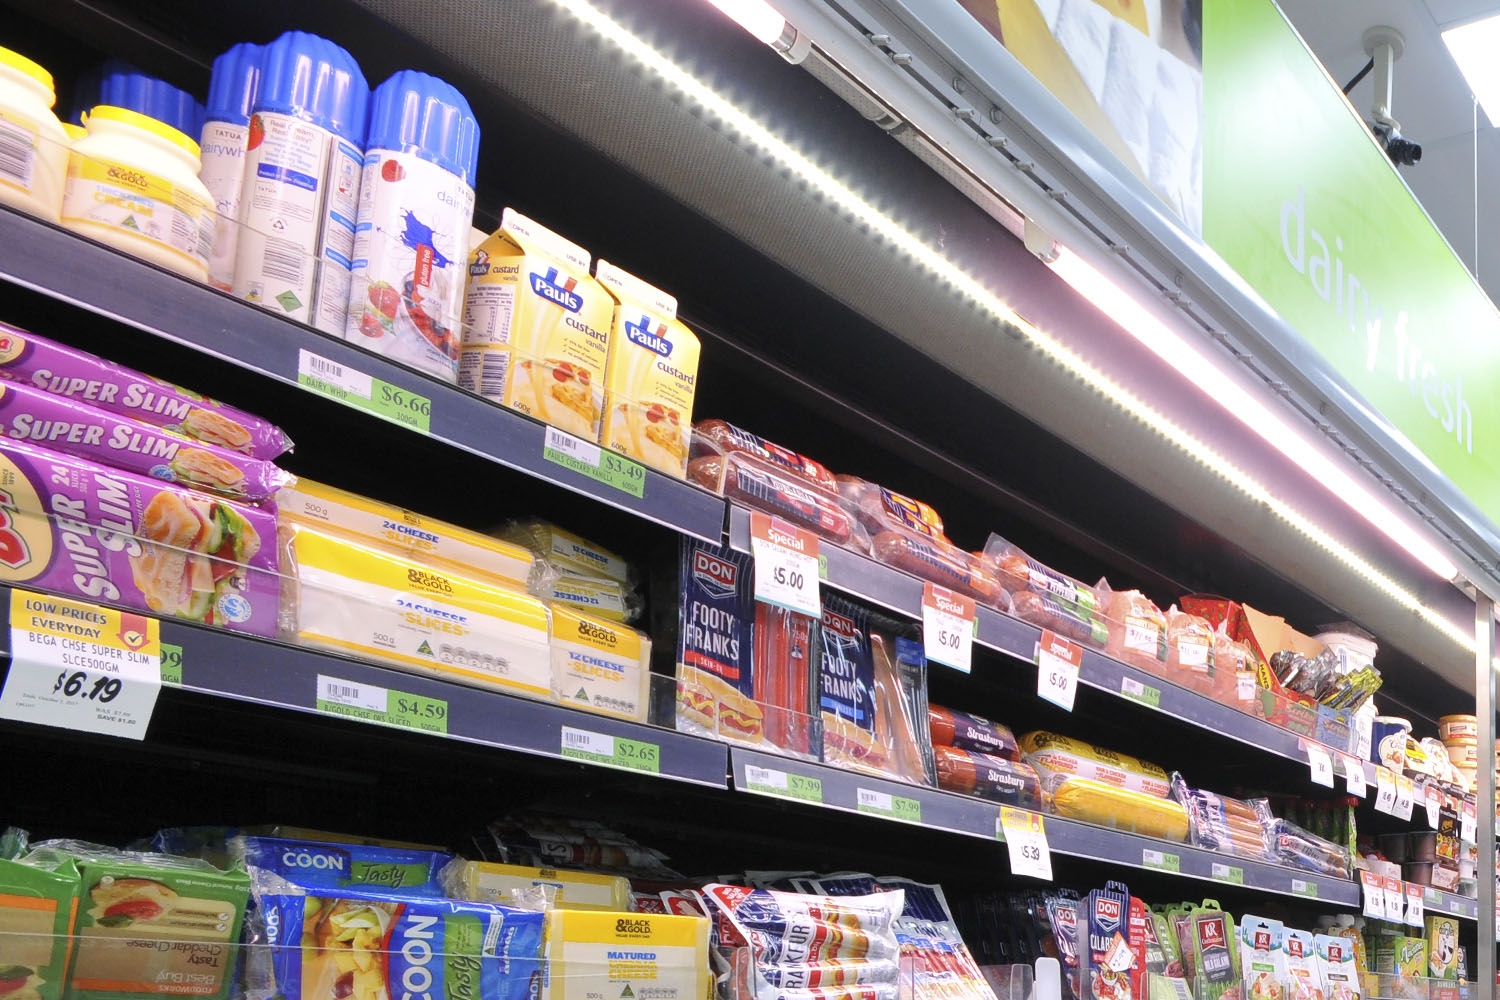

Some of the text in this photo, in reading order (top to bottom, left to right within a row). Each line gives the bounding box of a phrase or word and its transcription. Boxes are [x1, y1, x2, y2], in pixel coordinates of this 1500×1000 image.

[534, 277, 579, 311] Pauls
[565, 316, 608, 344] custard
[1280, 186, 1473, 455] dairy fresh
[585, 338, 607, 354] vanilla
[628, 329, 671, 357] Pauls
[656, 360, 696, 386] custard
[30, 369, 191, 420] SUPER SLIM
[306, 376, 349, 400] DAIRY WHIP
[381, 385, 431, 417] $6.66
[512, 400, 532, 415] 600g
[9, 412, 181, 460] SUPER SLIM
[604, 455, 644, 481] $3.49
[51, 473, 145, 601] SUPER SLIM
[767, 528, 804, 551] Special
[696, 554, 734, 580] DON
[773, 566, 804, 590] $5.00
[26, 599, 108, 626] LOW PRICES
[692, 600, 735, 632] FOOTY
[31, 616, 102, 640] EVERYDAY
[28, 631, 151, 665] BEGA CHSE SUPER SLIM
[686, 623, 740, 661] FRANKS
[62, 653, 121, 674] SLCE500GM
[52, 670, 123, 704] $6.19
[1258, 663, 1270, 690] HANS
[397, 697, 447, 720] $4.59
[966, 726, 1004, 750] Strasburg
[618, 742, 656, 762] $2.65
[790, 777, 821, 793] $7.99
[987, 768, 1025, 791] Strasburg
[894, 798, 920, 814] $7.99
[282, 851, 345, 871] COON
[360, 863, 407, 889] Tasty
[1097, 902, 1118, 915] DON
[628, 924, 651, 934] GOLD
[607, 950, 657, 962] MATURED
[156, 970, 216, 984] Best Buy
[608, 968, 658, 980] CHEESE
